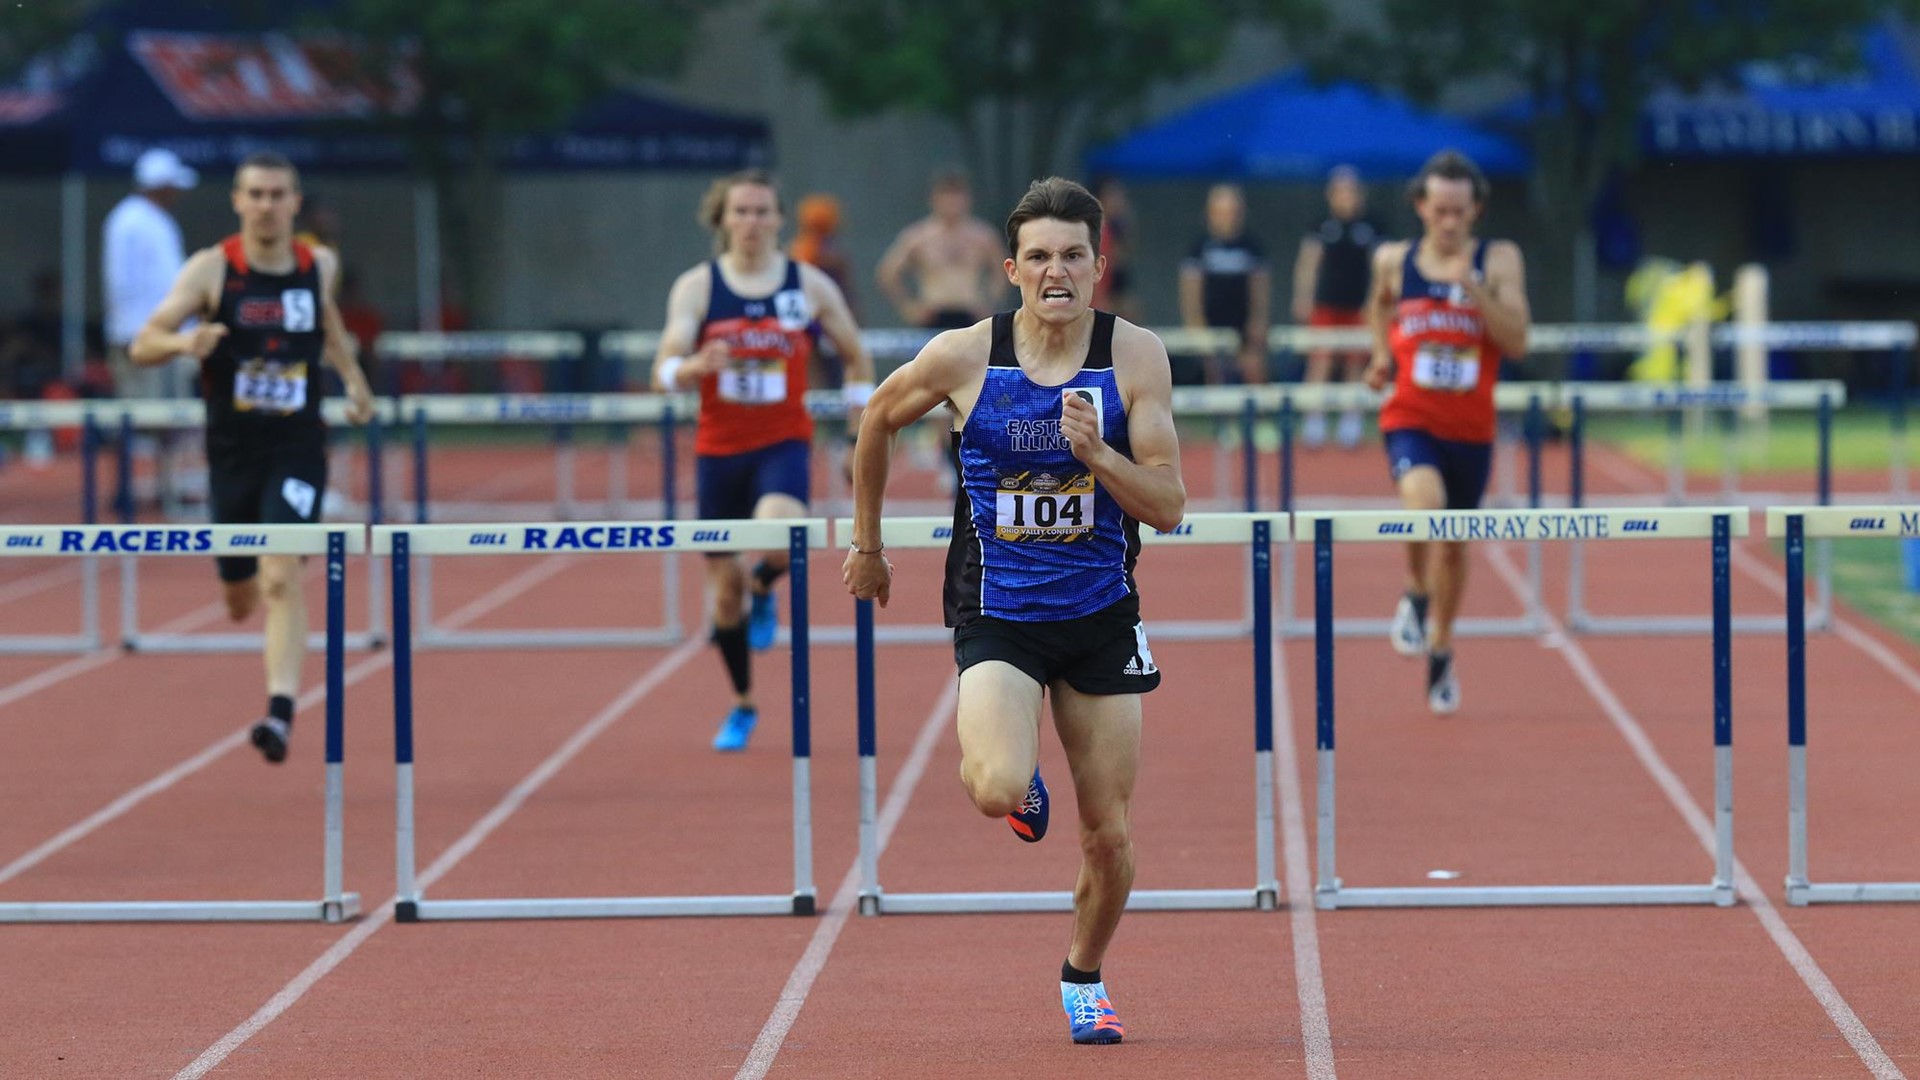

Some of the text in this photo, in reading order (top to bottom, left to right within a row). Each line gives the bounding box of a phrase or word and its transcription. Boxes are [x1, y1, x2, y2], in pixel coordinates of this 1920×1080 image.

[1013, 495, 1082, 527] 104
[1001, 527, 1089, 536] OHIO VALLEY CONFERENCE
[1378, 514, 1658, 540] GILL MURRAY STATE GILL
[1850, 518, 1884, 529] GILL
[7, 530, 268, 551] GILL RACERS GILL
[469, 526, 730, 549] GILL RACERS GILL
[1123, 668, 1142, 676] adidas
